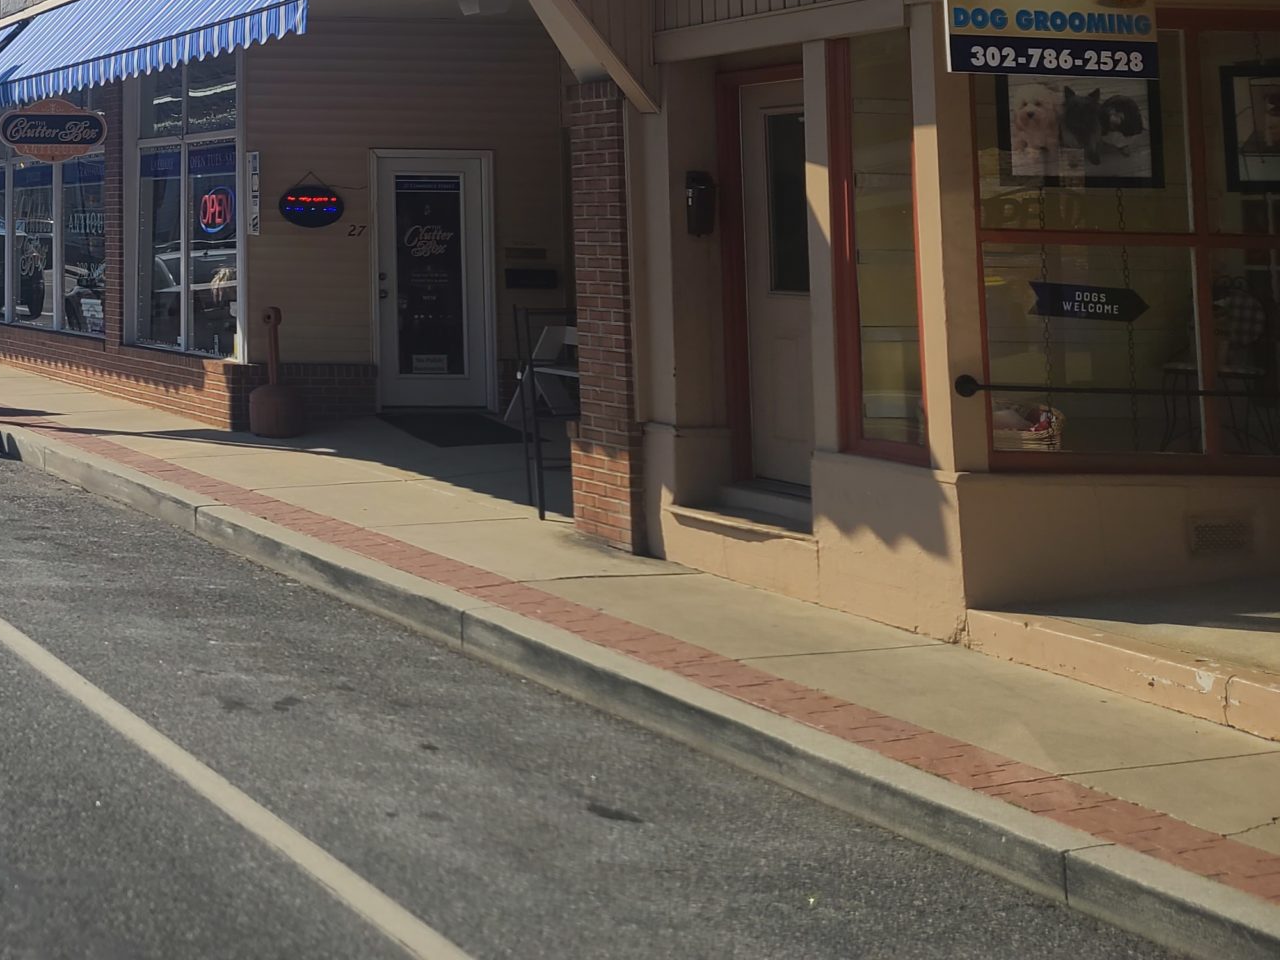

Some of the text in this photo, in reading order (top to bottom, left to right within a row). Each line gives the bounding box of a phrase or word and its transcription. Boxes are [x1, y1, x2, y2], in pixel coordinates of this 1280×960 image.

[952, 7, 1152, 36] DOG GROOMING
[970, 45, 1144, 72] 302-786-2528
[6, 118, 99, 141] Clutter Box
[200, 194, 232, 225] OPEN
[347, 224, 367, 237] 27
[404, 225, 454, 246] Clutter
[411, 240, 448, 257] Box
[1075, 291, 1107, 303] DOGS
[1062, 301, 1120, 315] WELCOME
